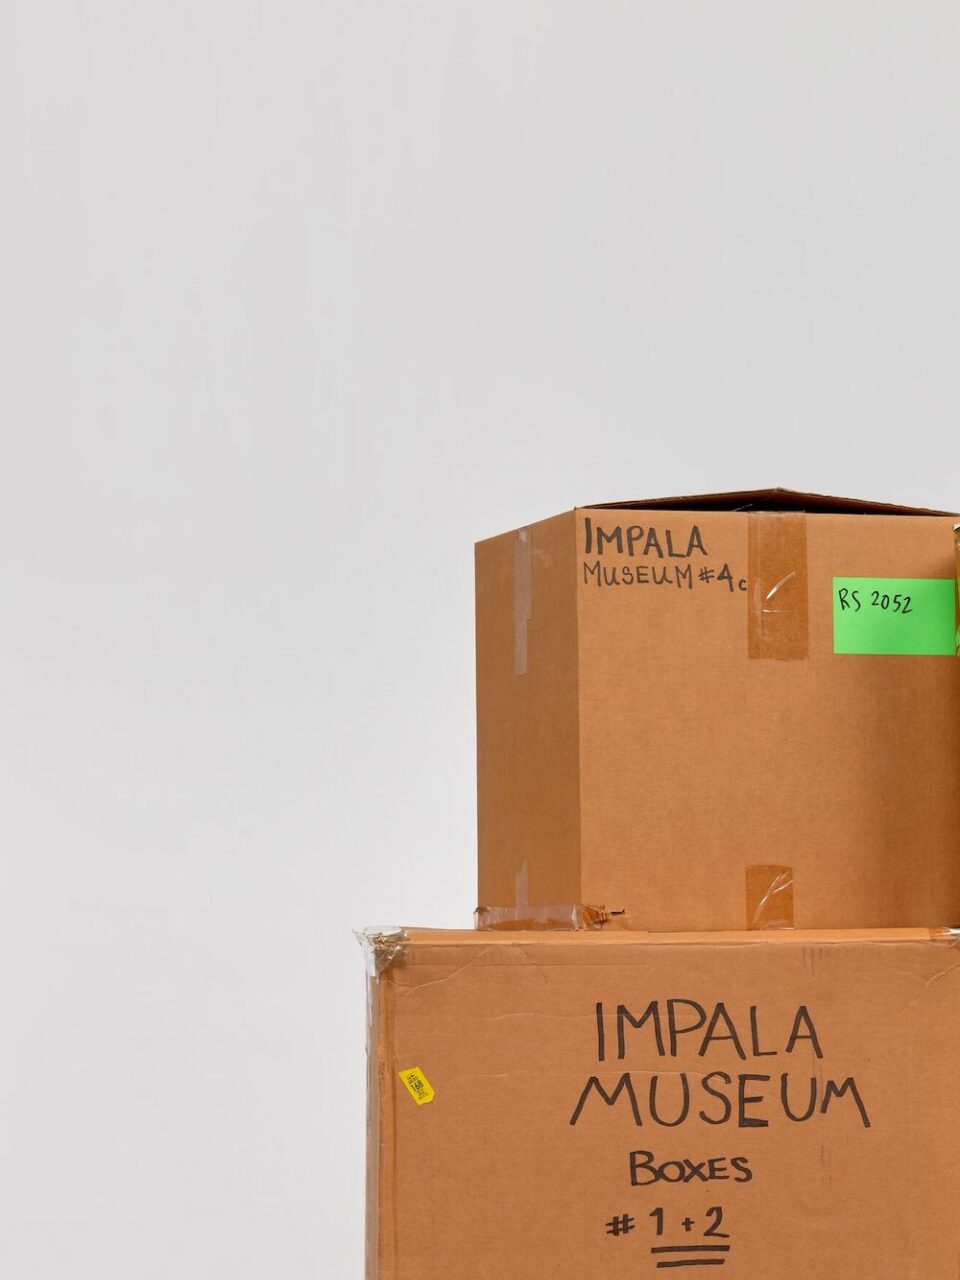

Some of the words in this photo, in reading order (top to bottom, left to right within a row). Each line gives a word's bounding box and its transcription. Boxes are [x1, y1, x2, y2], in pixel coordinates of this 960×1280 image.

[585, 517, 708, 558] IMPALA
[584, 560, 693, 589] MUSEUM
[838, 587, 861, 612] RS
[871, 590, 913, 614] 2052
[596, 998, 824, 1061] IMPALA
[569, 1070, 871, 1129] MUSEUM
[629, 1150, 753, 1187] BOXES
